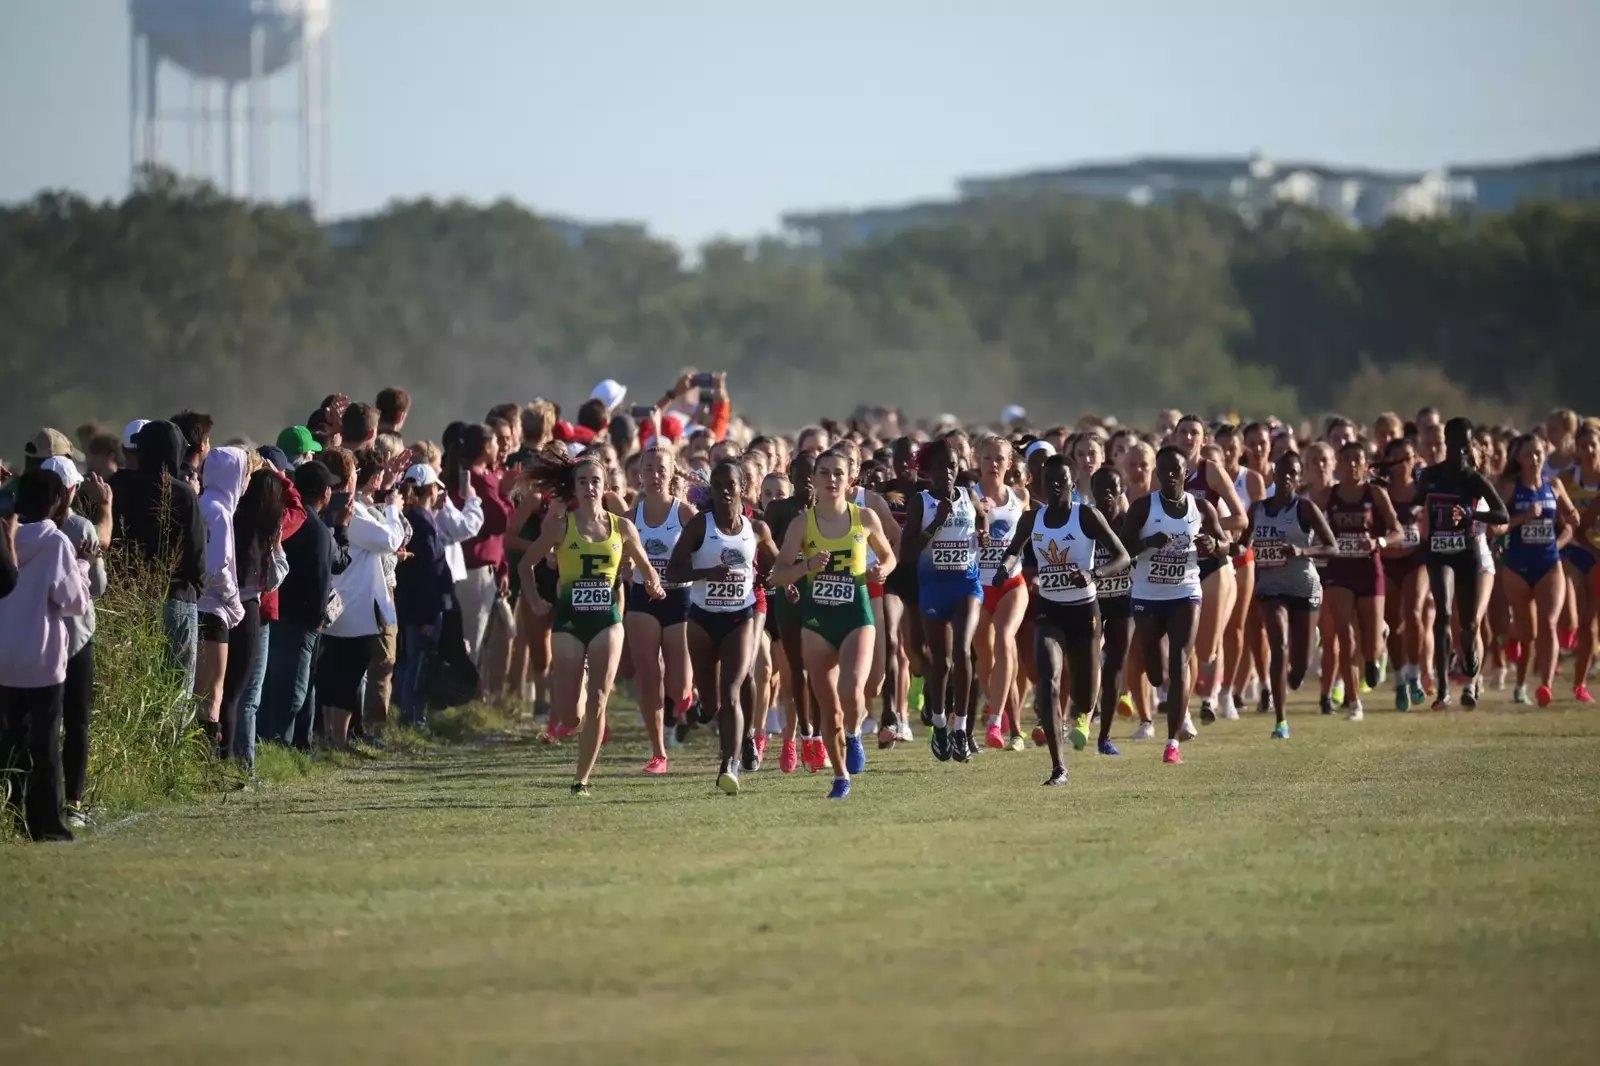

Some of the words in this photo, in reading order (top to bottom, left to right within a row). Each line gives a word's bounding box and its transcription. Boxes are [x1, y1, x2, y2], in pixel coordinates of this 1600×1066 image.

[1256, 525, 1279, 538] SFA
[1523, 526, 1552, 538] 2392
[1432, 536, 1464, 550] 2544
[824, 549, 852, 576] E
[934, 549, 968, 563] 2528
[980, 548, 1005, 562] 223
[580, 554, 610, 579] E
[1150, 563, 1185, 578] 2500
[1041, 573, 1072, 589] 220
[1097, 577, 1129, 591] 2375
[573, 589, 610, 604] 2269
[707, 583, 745, 598] 2296
[814, 582, 853, 599] 2268
